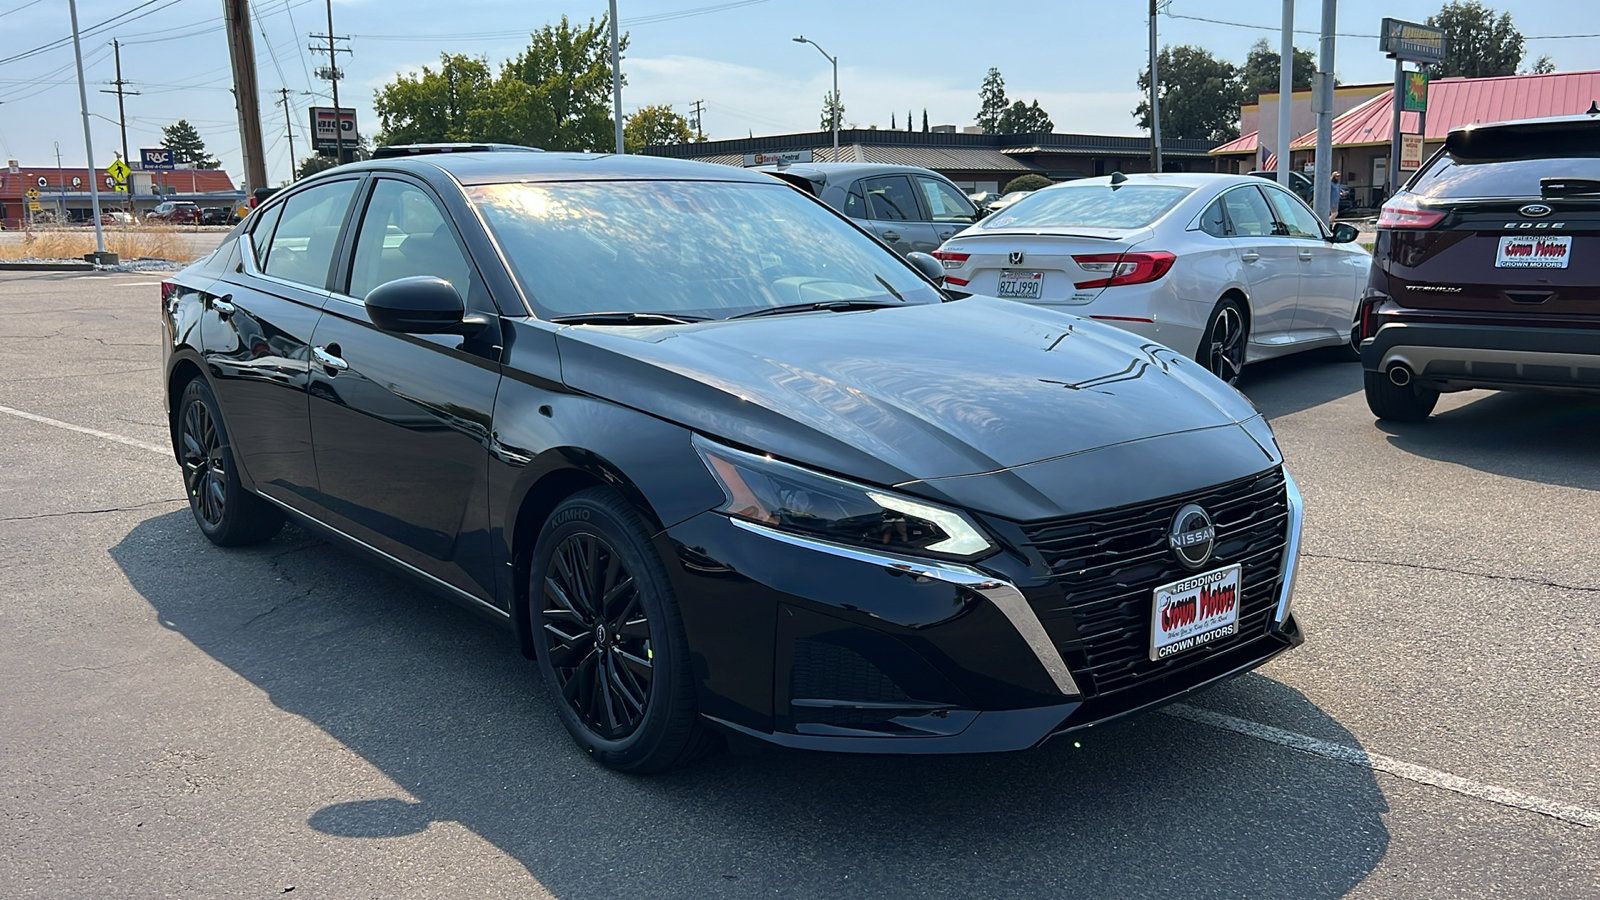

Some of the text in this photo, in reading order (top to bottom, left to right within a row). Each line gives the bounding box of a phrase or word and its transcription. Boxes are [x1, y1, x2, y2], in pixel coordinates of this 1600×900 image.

[146, 152, 169, 163] RAC
[1504, 240, 1567, 257] Crown Motors
[1000, 281, 1039, 294] 8ZIJ990
[1405, 285, 1462, 293] TITANIUM
[551, 508, 590, 529] KUMHO
[1171, 527, 1215, 547] NISSAN
[1177, 572, 1222, 593] REDDING
[1161, 582, 1236, 632] Crown Motors
[1159, 625, 1234, 657] CROWN MOTORS
